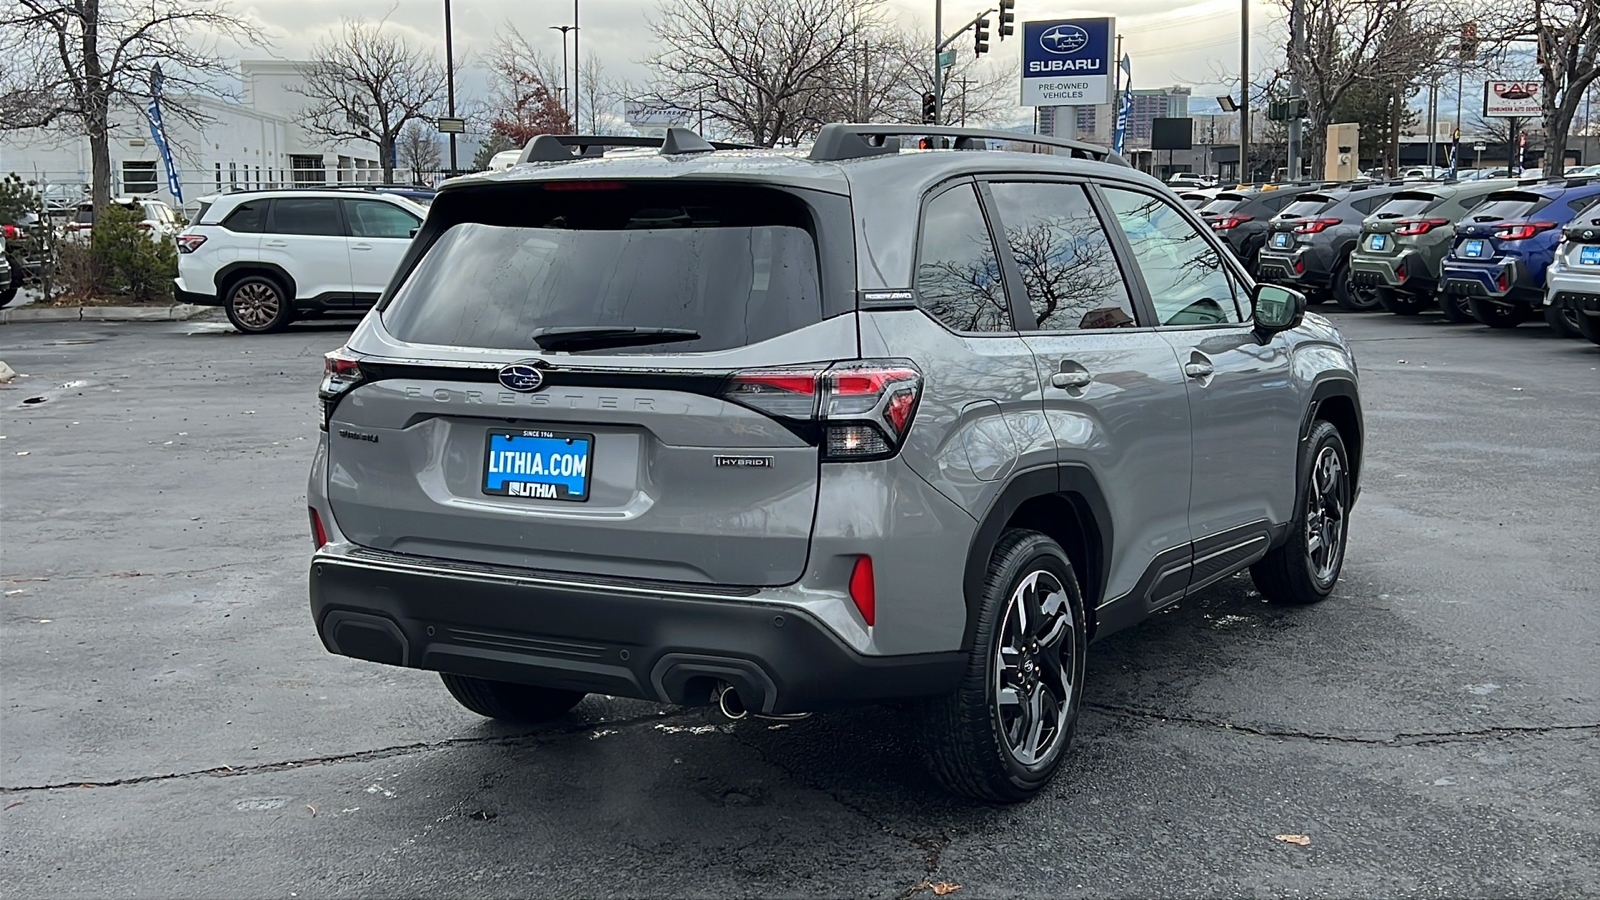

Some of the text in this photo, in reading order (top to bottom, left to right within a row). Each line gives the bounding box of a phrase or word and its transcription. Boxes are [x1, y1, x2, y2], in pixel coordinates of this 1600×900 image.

[1029, 59, 1100, 72] SUBARU
[1038, 82, 1089, 91] PRE-OWNED
[1494, 83, 1538, 92] CAC
[1043, 91, 1083, 99] VEHICLES
[404, 386, 656, 411] FORESTER
[489, 450, 587, 478] LITHIA.COM
[519, 482, 558, 499] LITHIA
